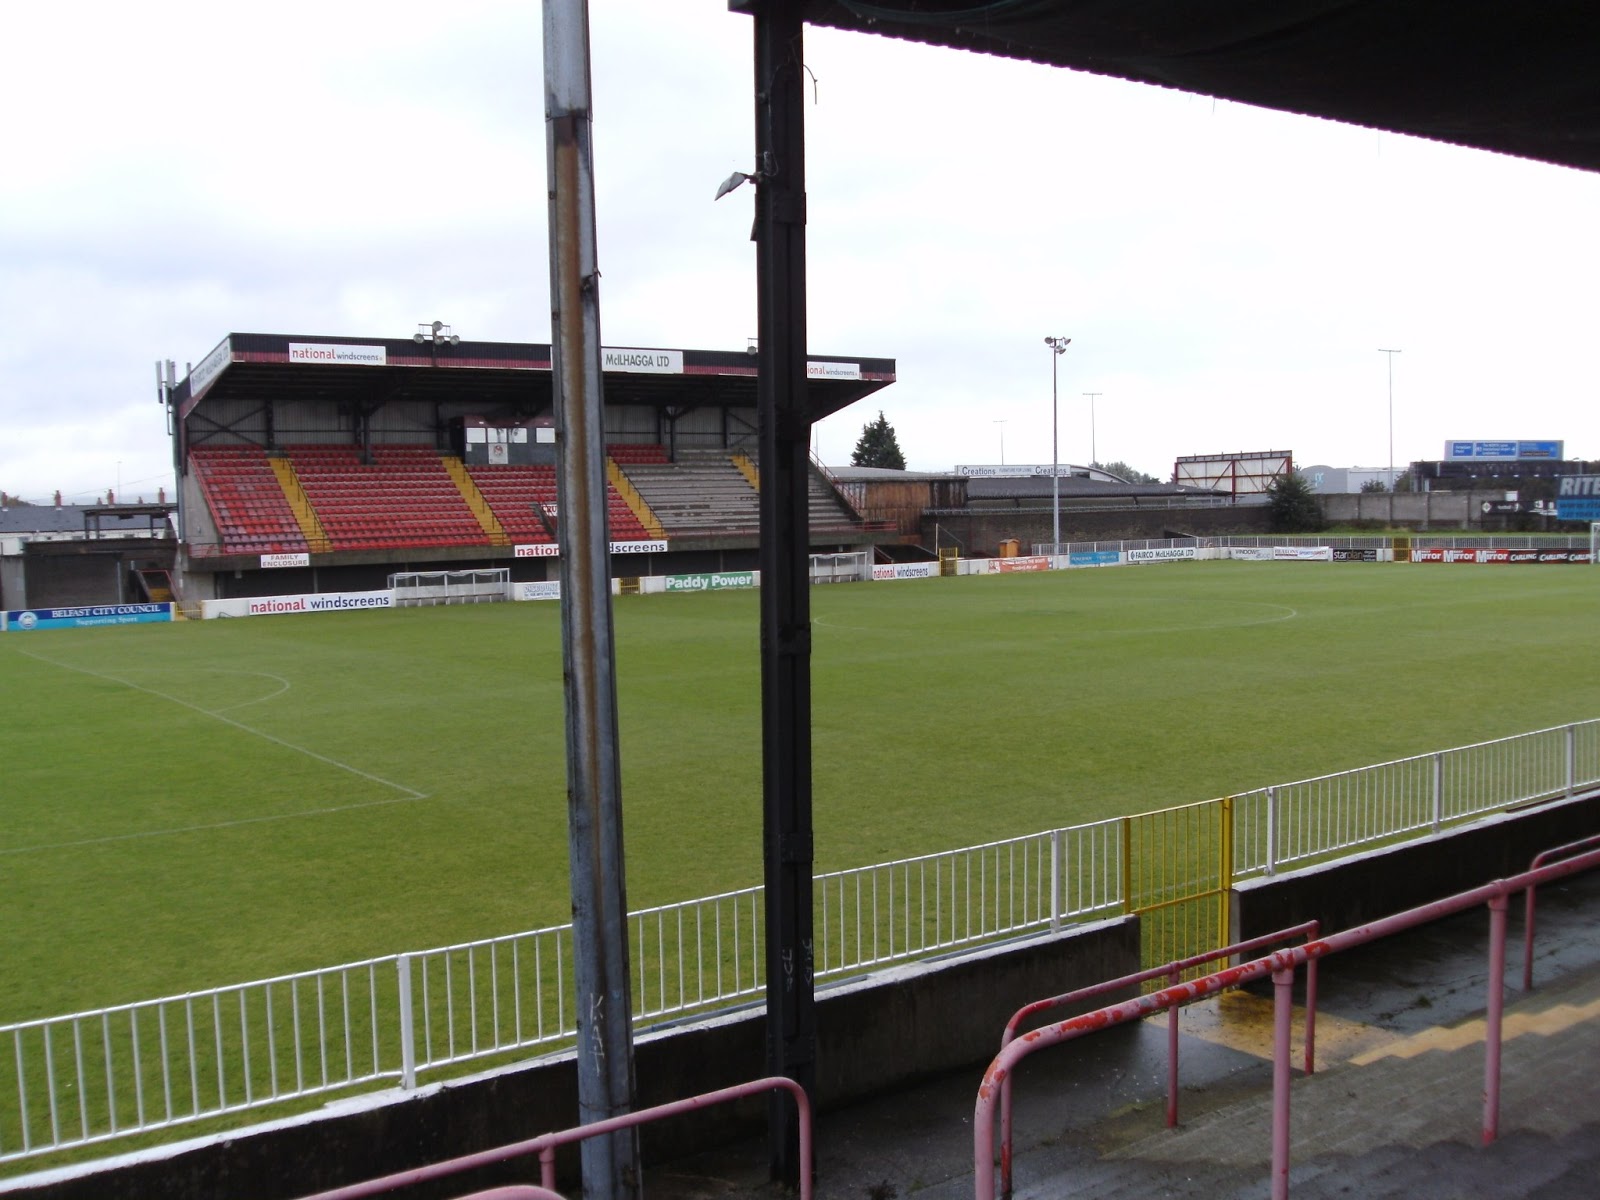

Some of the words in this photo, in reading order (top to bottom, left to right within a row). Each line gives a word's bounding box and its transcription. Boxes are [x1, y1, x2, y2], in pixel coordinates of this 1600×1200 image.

[292, 348, 336, 360] national
[336, 352, 379, 361] windscreens
[656, 355, 670, 367] LTD
[807, 364, 825, 375] ional
[962, 466, 996, 475] Creations
[1035, 466, 1066, 475] Creatns
[517, 545, 559, 556] nation
[610, 542, 665, 553] dscreens
[1135, 550, 1154, 559] FAIRCO
[1185, 549, 1194, 557] LTD
[1411, 550, 1442, 562] Mirror
[1443, 550, 1474, 562] Mirror
[1476, 550, 1508, 562] Mirror
[262, 559, 308, 567] ENCLOSURE
[873, 567, 896, 579] national
[897, 566, 929, 578] windscreens
[666, 576, 709, 590] Paddy
[711, 575, 752, 586] Power
[52, 608, 90, 618] BELFAST
[93, 606, 116, 616] CITY
[118, 604, 161, 614] COUNCIL
[251, 598, 306, 614] national
[310, 596, 390, 609] windscreens
[76, 618, 117, 626] Supporting
